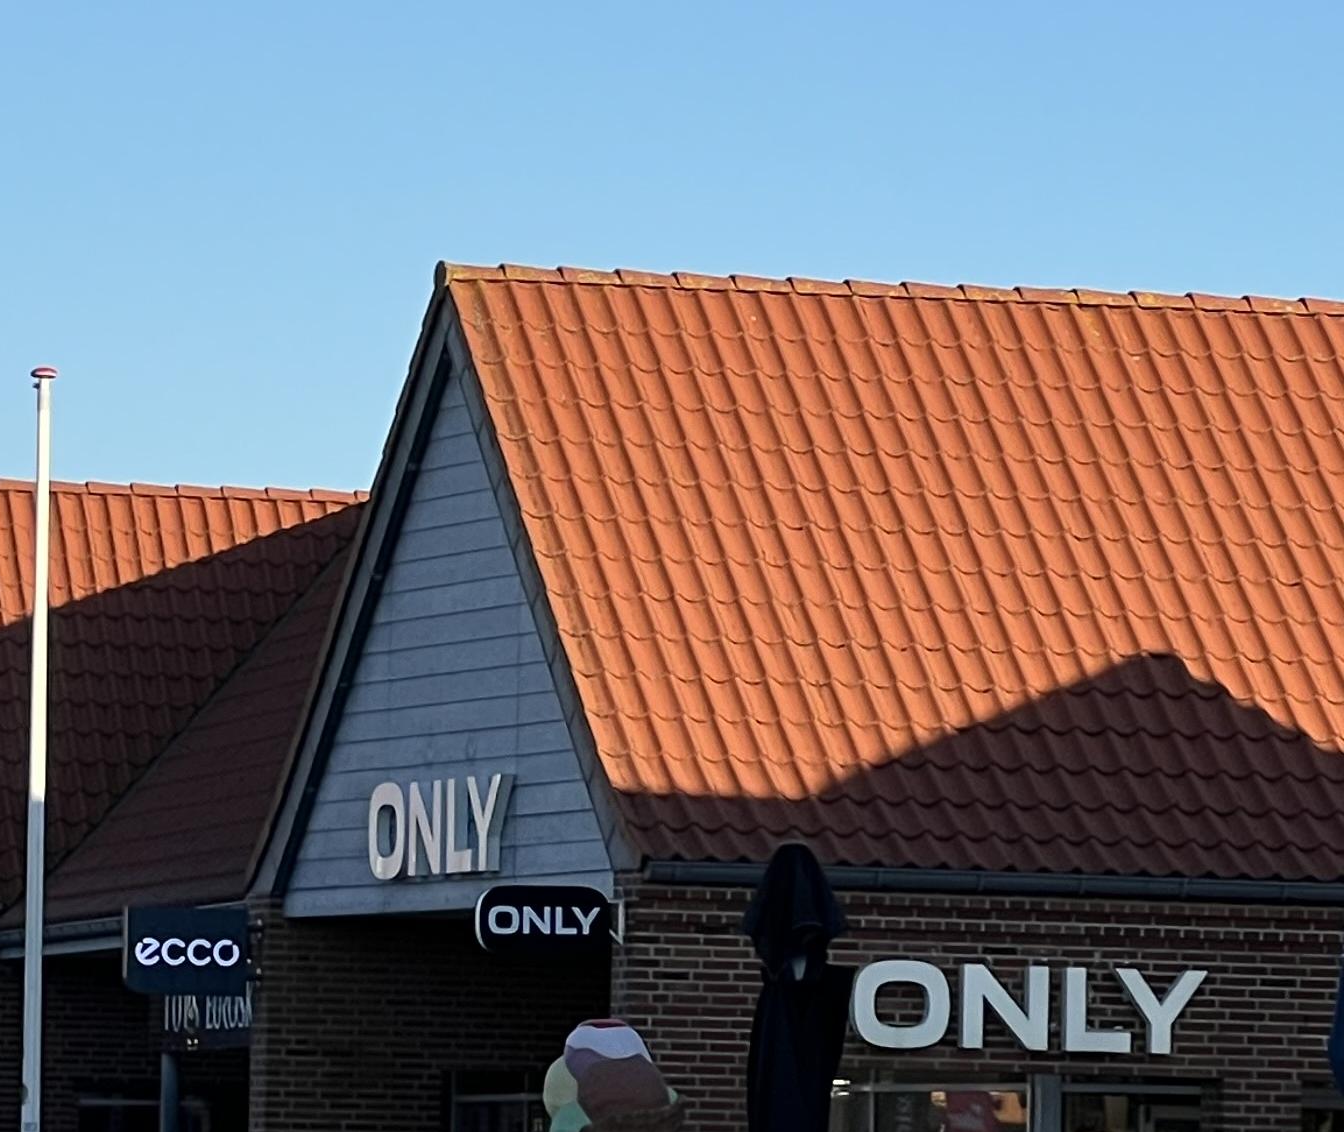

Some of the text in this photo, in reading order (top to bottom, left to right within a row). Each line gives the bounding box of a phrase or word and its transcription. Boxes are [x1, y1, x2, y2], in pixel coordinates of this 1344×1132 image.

[368, 774, 514, 881] ONLY
[134, 937, 240, 967] ecco
[487, 903, 602, 937] ONLY
[850, 959, 1209, 1055] ONLY
